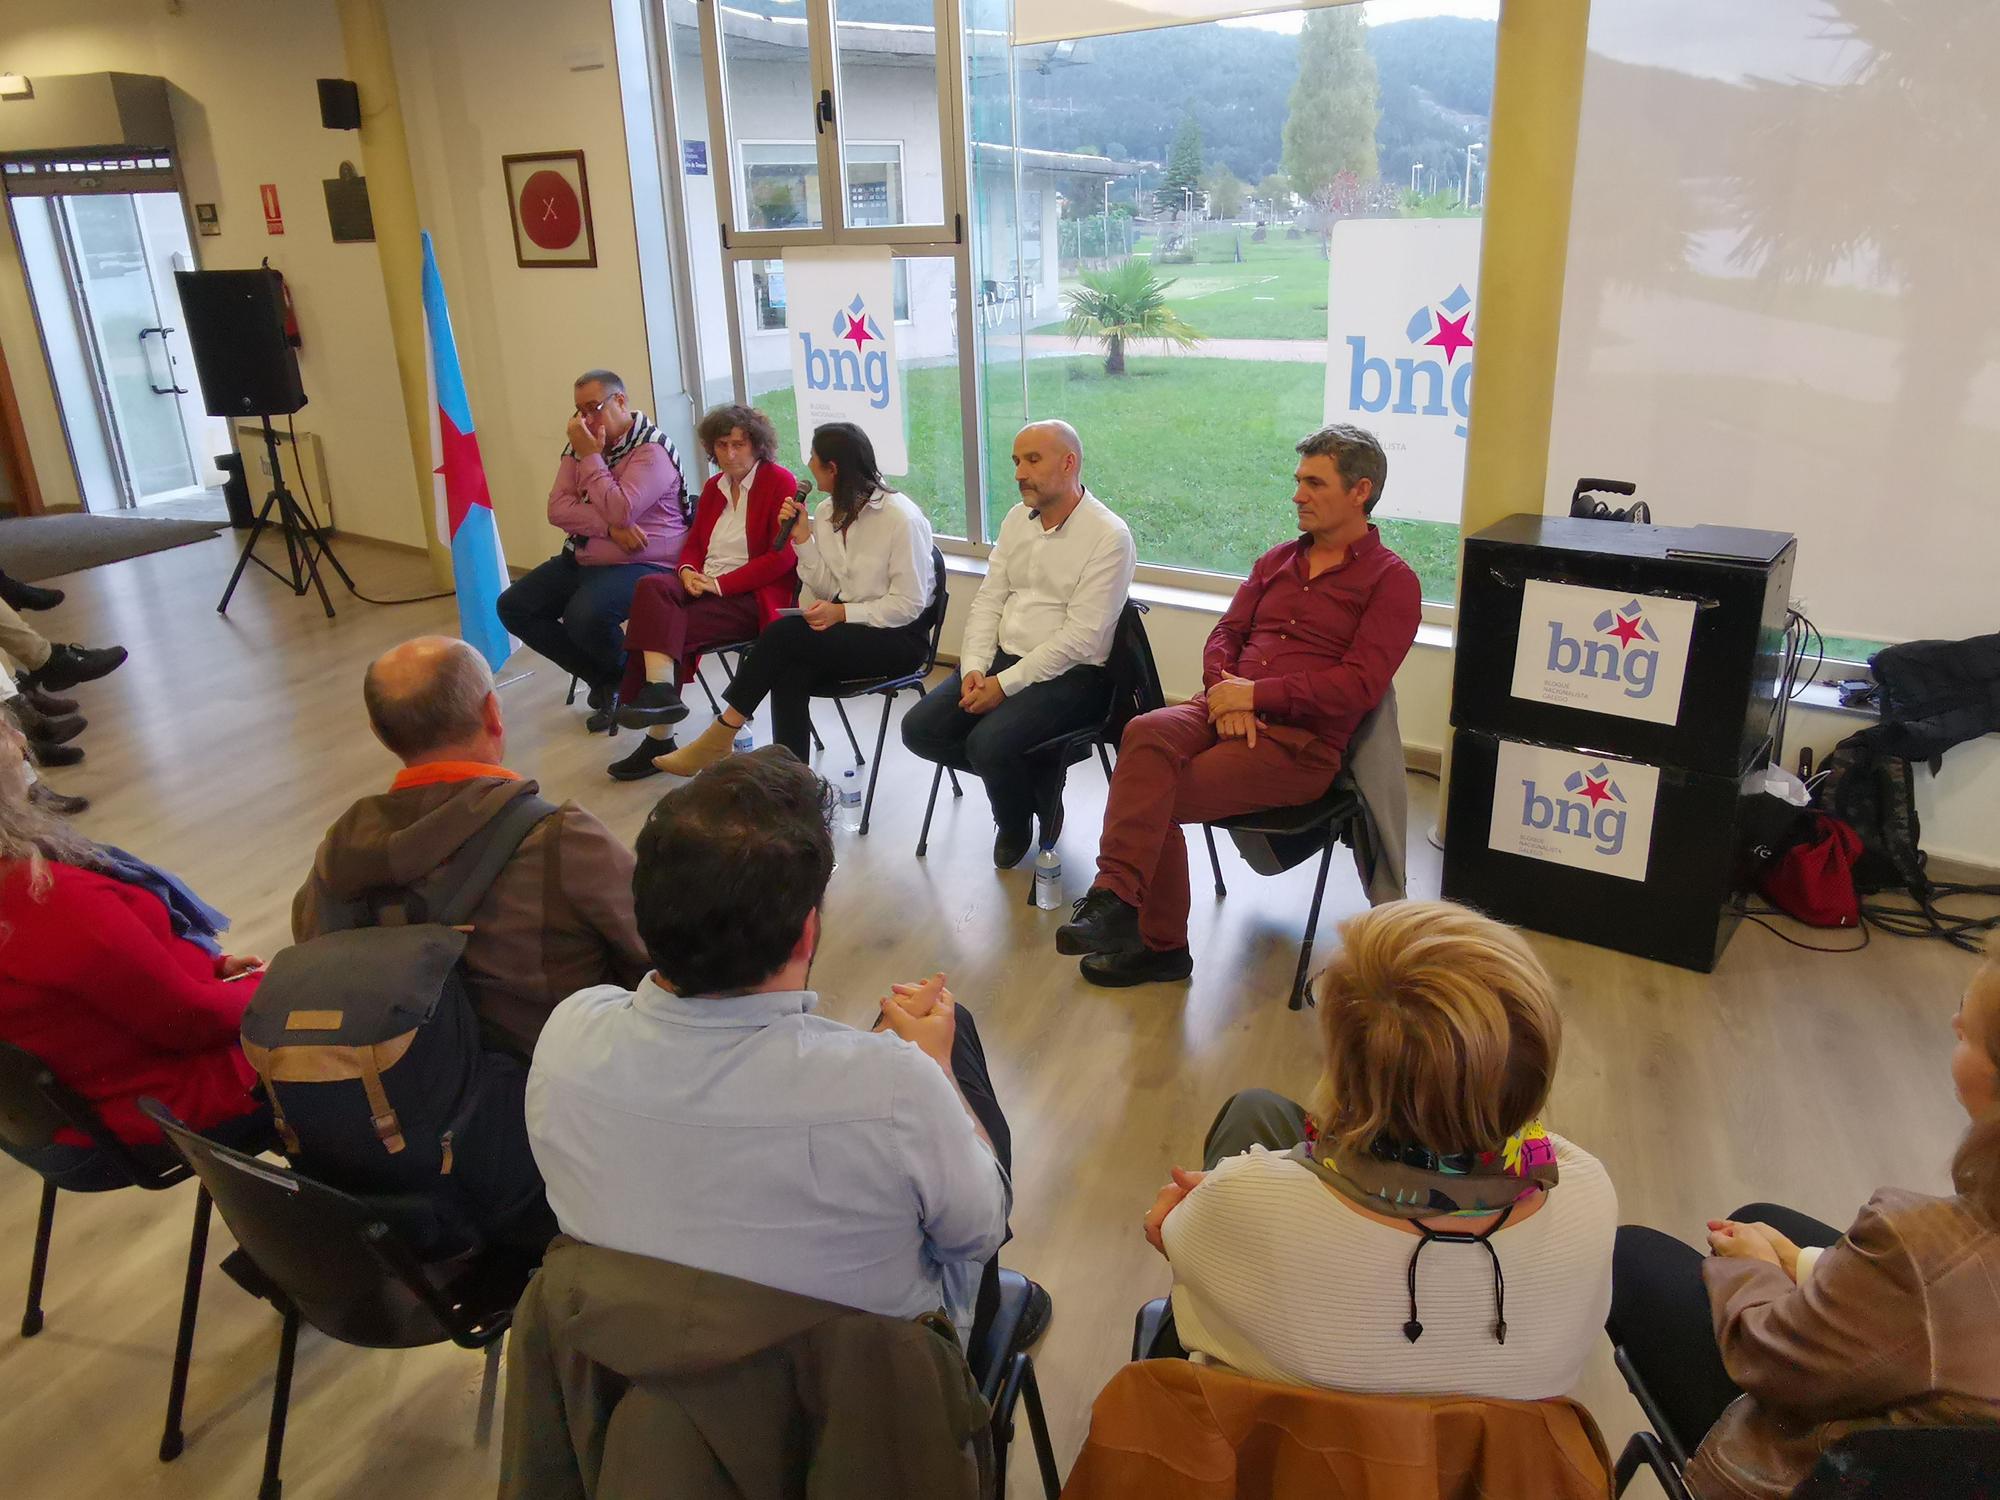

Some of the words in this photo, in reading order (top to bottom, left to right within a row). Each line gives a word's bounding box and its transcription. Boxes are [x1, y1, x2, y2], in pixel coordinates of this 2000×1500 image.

[799, 332, 890, 409] bng
[1547, 620, 1660, 699] bng
[1521, 779, 1628, 856] bng
